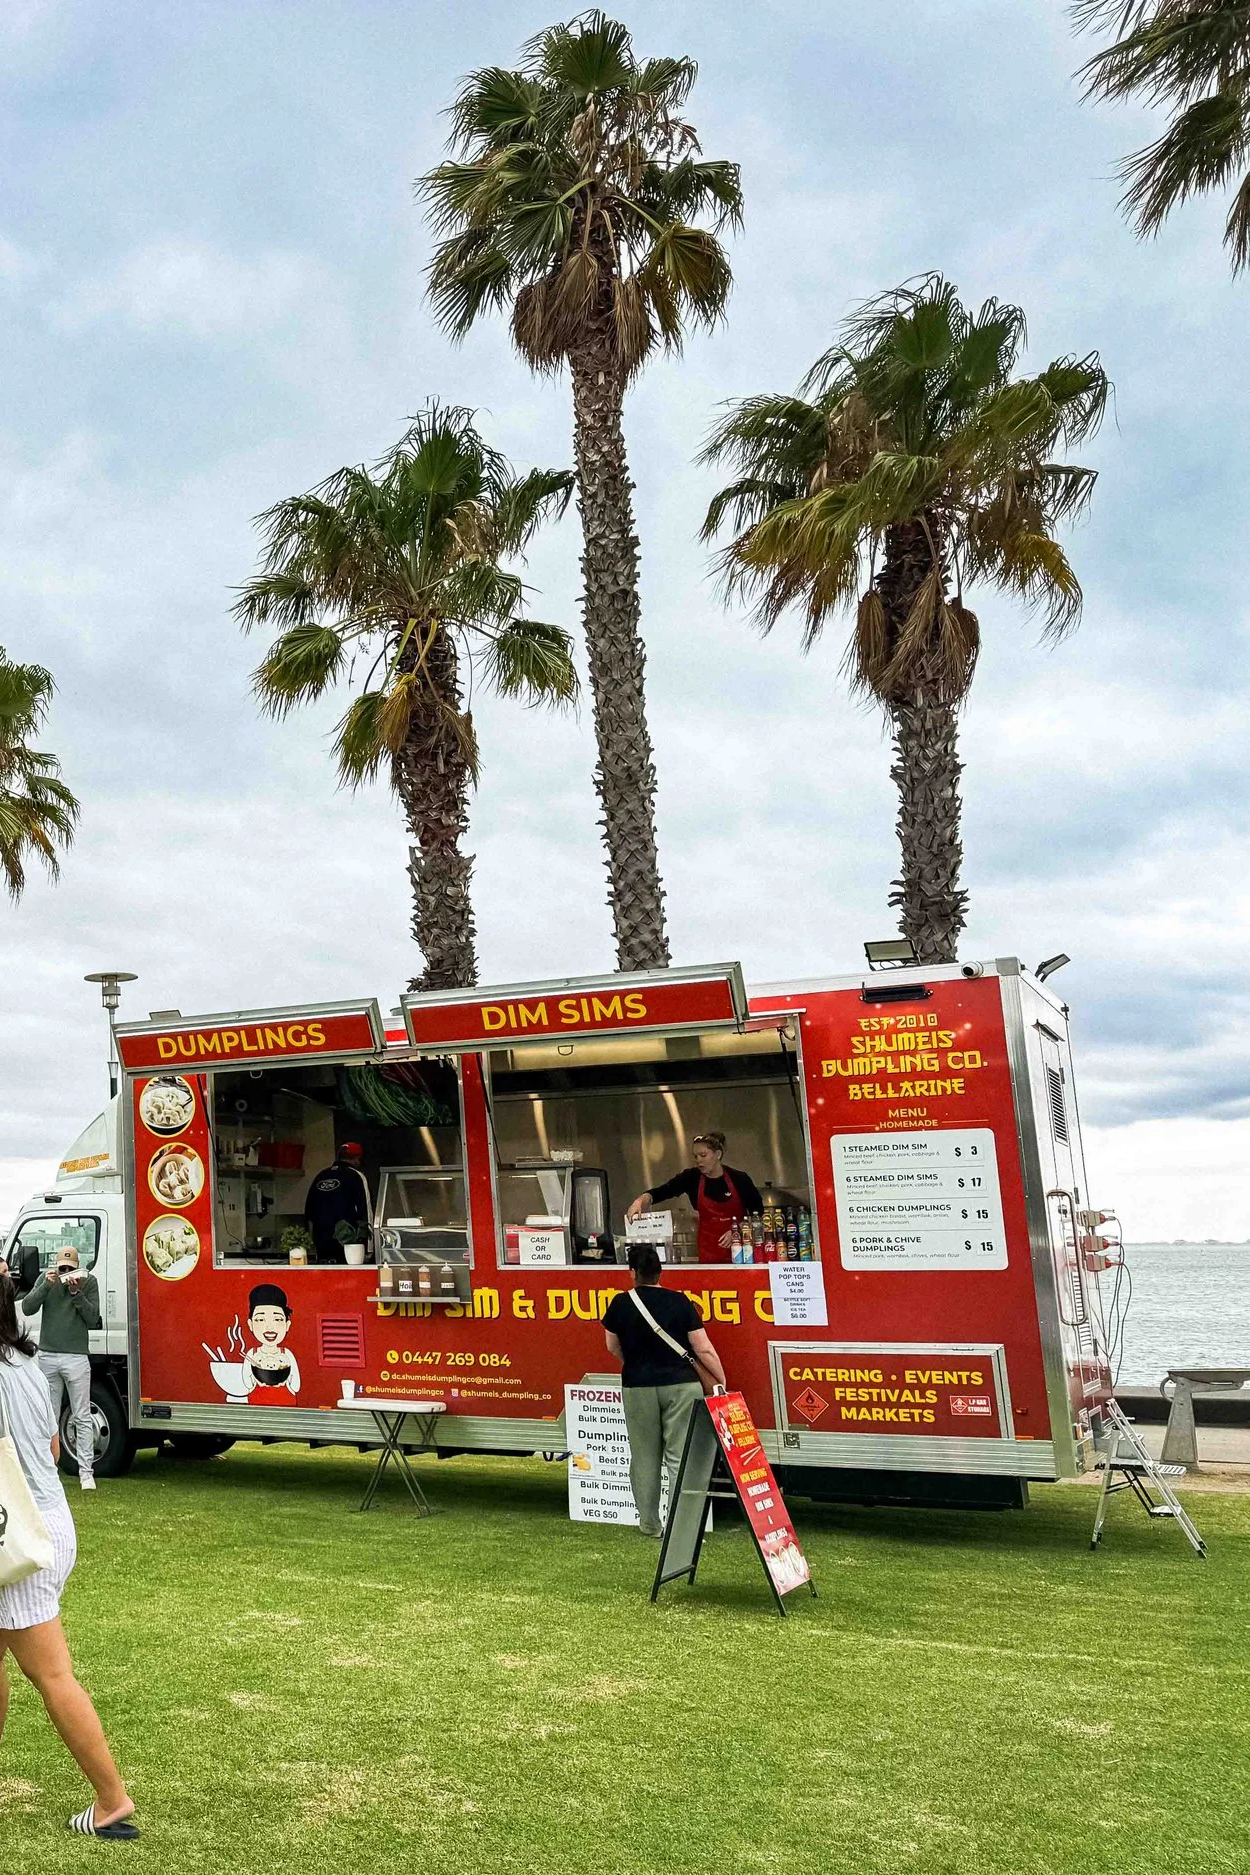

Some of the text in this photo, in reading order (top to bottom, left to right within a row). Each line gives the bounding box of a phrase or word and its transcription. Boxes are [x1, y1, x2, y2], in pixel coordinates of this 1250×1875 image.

[481, 993, 647, 1031] DIM SIMS
[858, 1013, 938, 1031] EST 2010
[157, 1023, 326, 1059] DUMPLINGS
[850, 1030, 954, 1054] SHUMEIS
[821, 1053, 940, 1078] DUMPLING
[848, 1078, 965, 1101] BELLARINE
[888, 1107, 927, 1118] MENU
[879, 1119, 939, 1129] HOMEMADE
[848, 1144, 890, 1152] STEAMED
[954, 1147, 962, 1157] $
[970, 1146, 978, 1156] 3
[916, 1173, 938, 1181] SIMS
[957, 1178, 965, 1188] $
[971, 1177, 982, 1187] 17
[856, 1205, 895, 1213] CHICKEN
[897, 1204, 952, 1212] DUMPLINGS
[961, 1209, 968, 1219] $
[976, 1209, 989, 1219] 15
[530, 1236, 550, 1244] CASH
[964, 1240, 972, 1251] $
[980, 1242, 994, 1252] 15
[531, 1253, 551, 1261] CARD
[513, 1288, 535, 1320] &
[402, 1350, 511, 1368] 0447 269 084
[789, 1367, 984, 1386] CATERING EVENTS
[570, 1389, 621, 1403] FROZEN
[834, 1387, 938, 1404] FESTIVALS
[582, 1405, 621, 1413] Dimmies
[840, 1406, 936, 1423] MARKETS
[600, 1416, 626, 1424] Dimm
[586, 1443, 607, 1452] Pork
[598, 1455, 630, 1465] Beef $1
[600, 1469, 617, 1477] Bulk
[580, 1481, 631, 1492] Bulk Dimmi
[580, 1497, 599, 1505] Bulk
[583, 1509, 618, 1519] VEG $50
